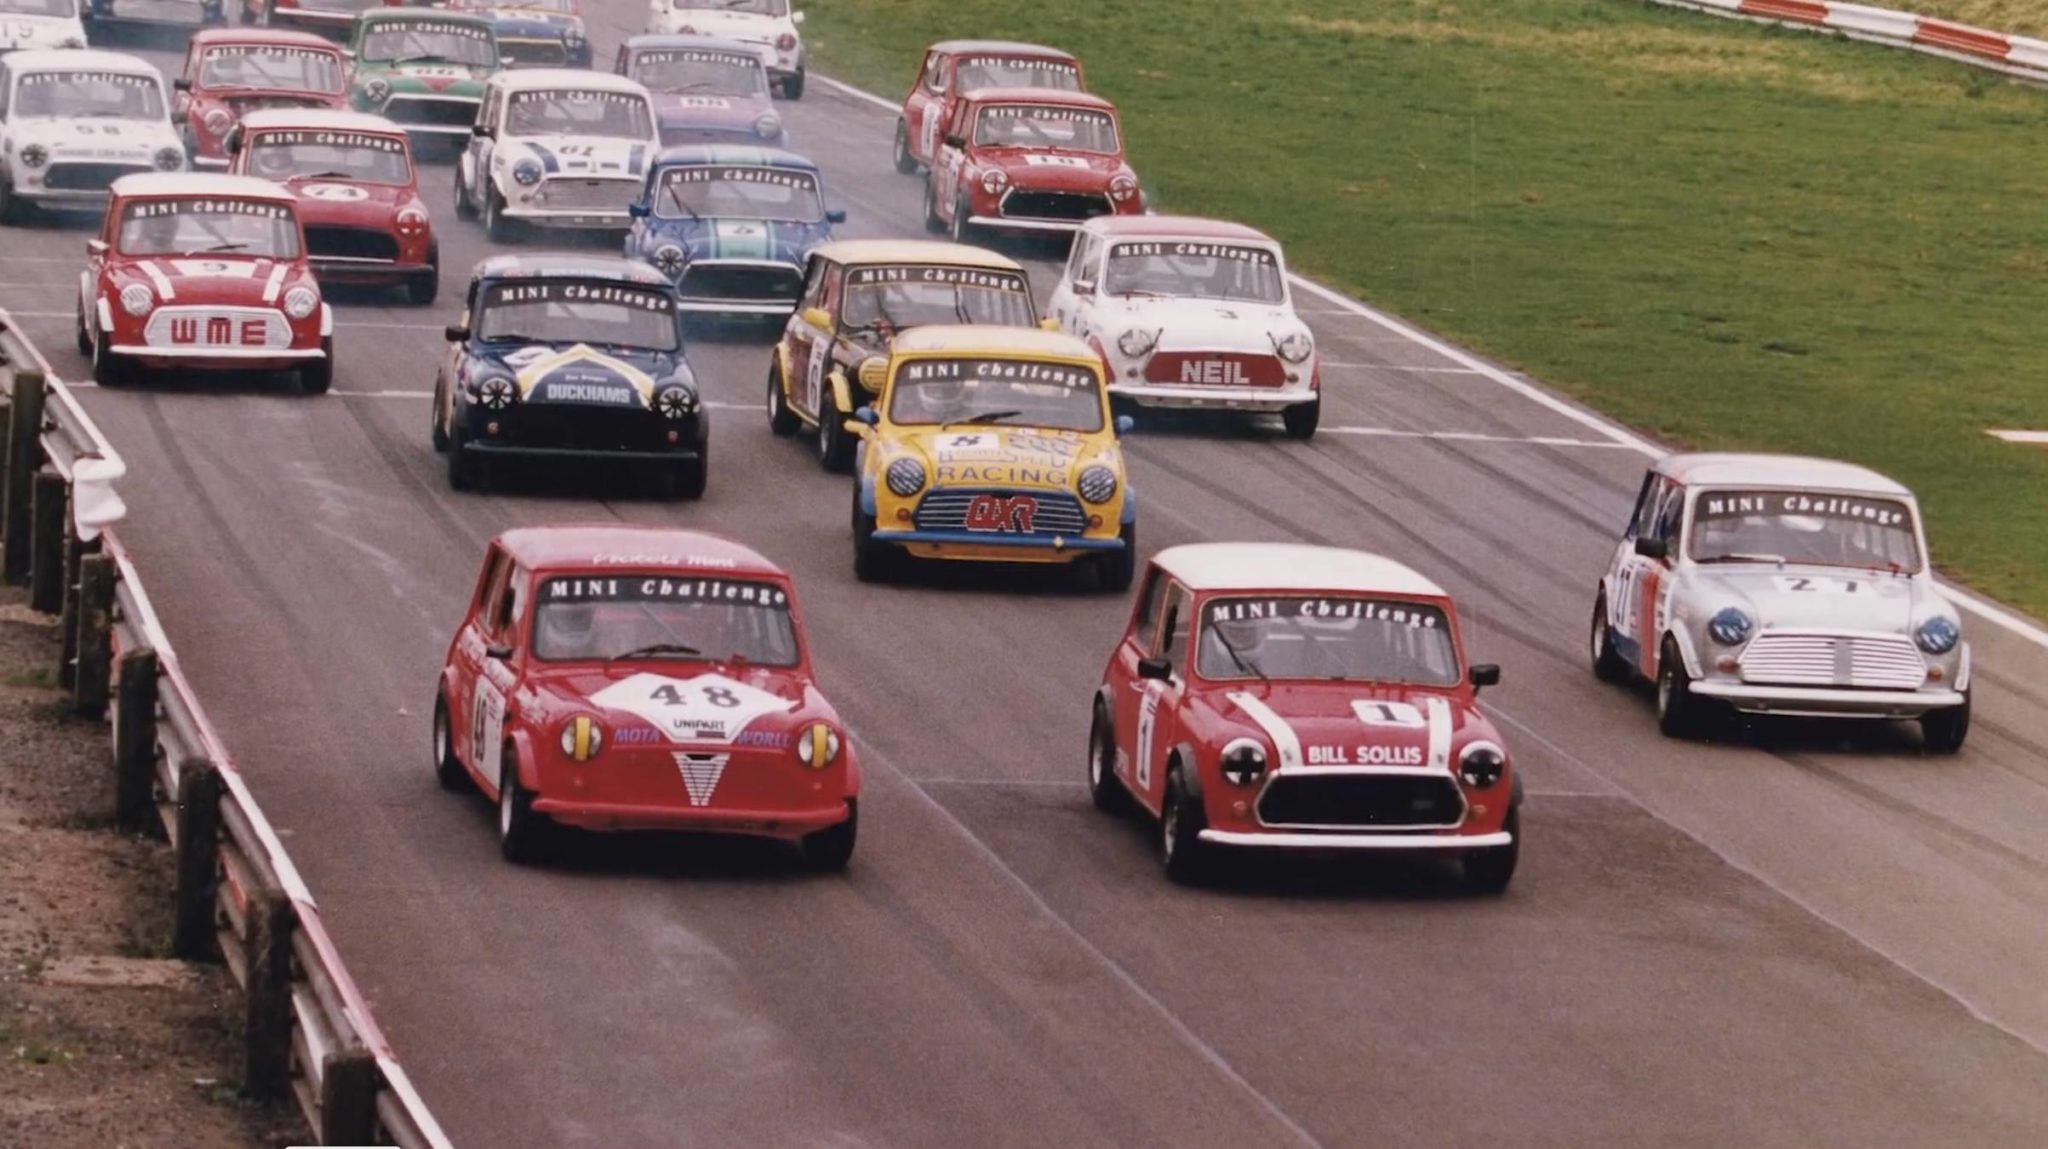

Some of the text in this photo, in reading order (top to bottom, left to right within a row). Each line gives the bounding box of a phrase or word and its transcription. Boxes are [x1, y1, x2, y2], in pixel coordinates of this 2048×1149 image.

[372, 22, 487, 39] MINI Challenge
[640, 52, 755, 67] MINI Challenge
[970, 58, 1077, 75] MINI Challenge
[519, 93, 556, 103] MINI
[988, 109, 1107, 125] MINI Challenge
[264, 132, 401, 151] MINI Challenge
[671, 170, 811, 189] MINI Challenge
[135, 201, 288, 219] MINI Challenge
[1118, 243, 1269, 264] MINI Challenge
[861, 269, 907, 282] MINI
[502, 285, 668, 310] MINI Challenge
[171, 317, 267, 346] WME
[909, 362, 1089, 387] MINI Challenge
[1180, 360, 1250, 385] NEIL
[547, 383, 631, 404] DUCKHAMS
[936, 466, 1068, 486] RACING
[1708, 496, 1904, 525] MINI Challenge
[551, 579, 785, 606] MINI Challenge
[1213, 600, 1436, 629] MINI Challenge
[673, 719, 727, 731] UNIPART
[613, 728, 661, 744] MOTA
[1308, 745, 1423, 765] BILL SOLLIS
